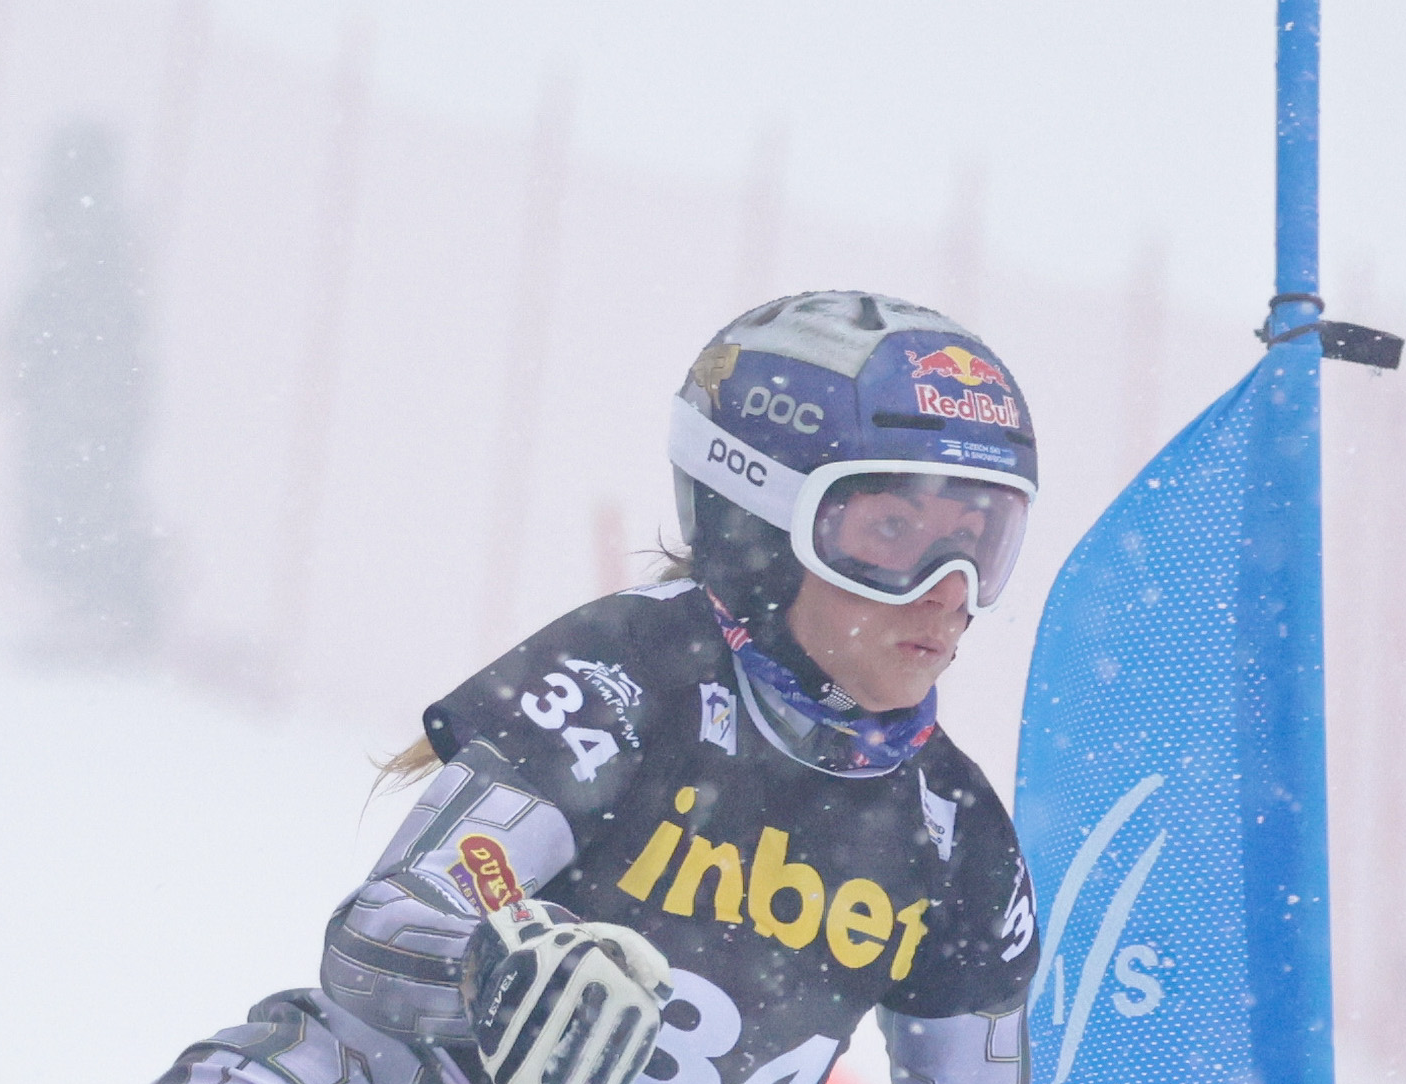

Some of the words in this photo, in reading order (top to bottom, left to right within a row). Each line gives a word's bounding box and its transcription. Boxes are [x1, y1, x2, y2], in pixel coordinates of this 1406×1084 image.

[741, 386, 824, 434] poc
[915, 383, 976, 420] Red
[974, 392, 1020, 428] Bull
[707, 437, 768, 487] poc
[521, 672, 620, 783] 34
[616, 787, 929, 981] inbet
[485, 970, 519, 1028] LEVEL
